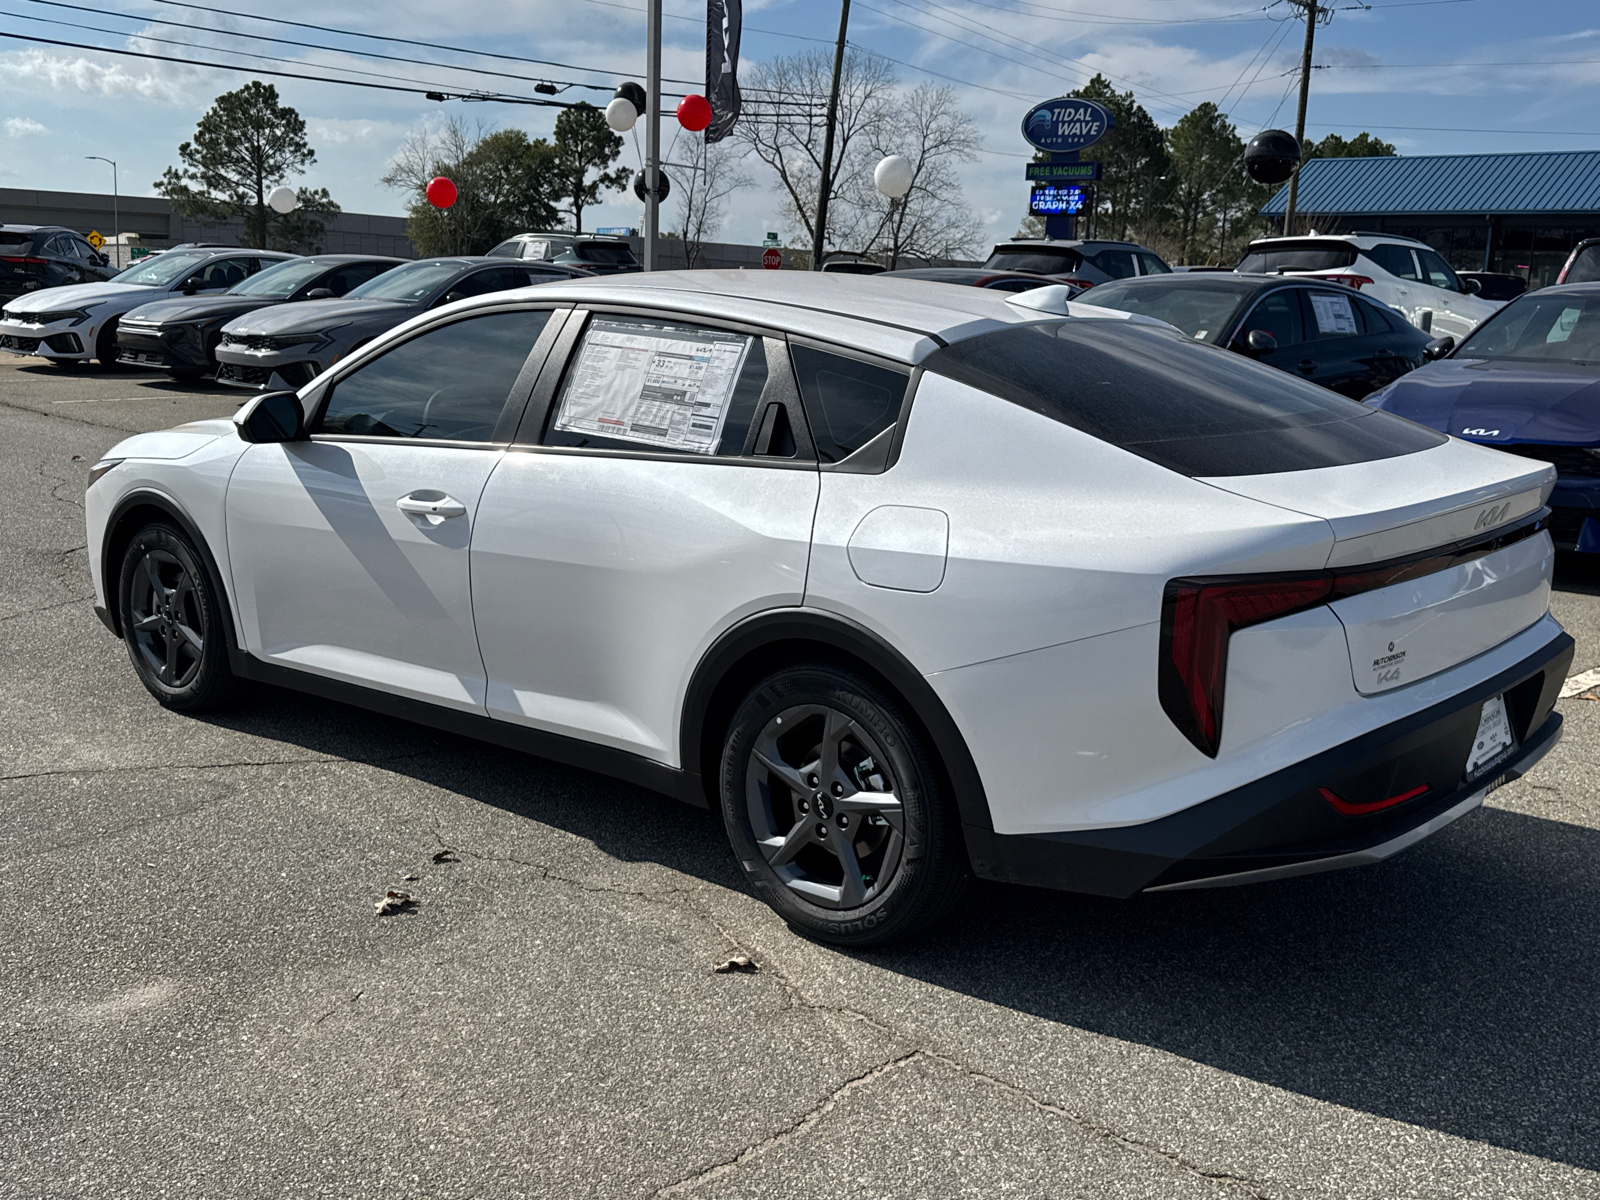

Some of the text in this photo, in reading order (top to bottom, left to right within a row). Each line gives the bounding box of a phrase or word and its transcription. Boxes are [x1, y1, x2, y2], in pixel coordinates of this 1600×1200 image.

[1052, 107, 1092, 121] TIDAL
[1057, 122, 1100, 136] WAVE
[1029, 165, 1093, 176] FREE VACUUMS
[763, 255, 781, 266] STOP
[656, 359, 666, 367] 33
[1462, 427, 1500, 437] KIA
[1474, 501, 1511, 530] KIA
[1377, 667, 1400, 685] K4
[834, 687, 896, 747] KUMHO
[817, 791, 828, 819] KIA
[827, 907, 888, 934] SOLUS
